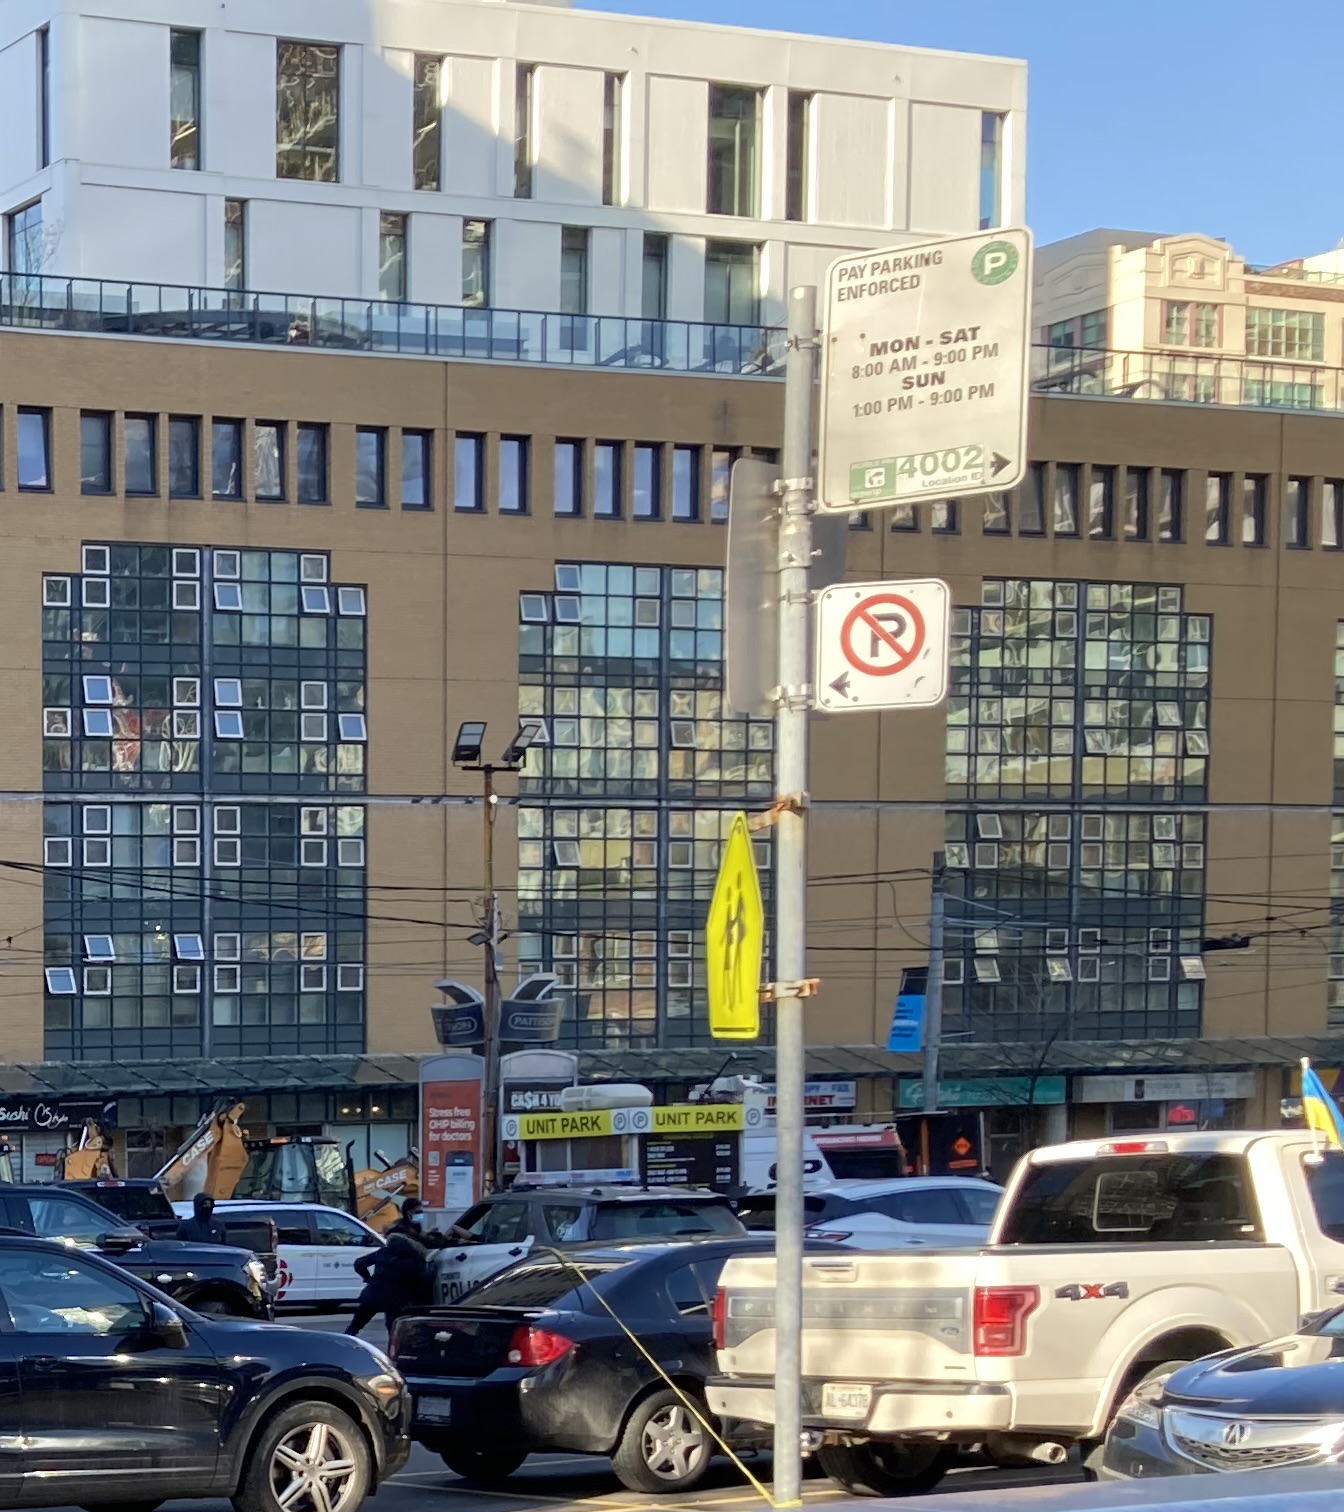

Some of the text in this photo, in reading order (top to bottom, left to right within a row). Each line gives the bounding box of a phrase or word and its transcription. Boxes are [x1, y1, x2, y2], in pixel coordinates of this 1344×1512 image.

[838, 250, 943, 282] PAY PARKING
[837, 274, 921, 302] ENFORCED
[869, 335, 920, 357] MON
[940, 325, 982, 346] SAT
[851, 361, 883, 379] 8:00
[888, 356, 917, 374] AM
[933, 348, 967, 367] 9:00
[972, 342, 999, 361] PM
[902, 371, 946, 390] SUN
[852, 400, 882, 418] 1:00
[887, 395, 913, 412] PM
[930, 388, 963, 406] 9:00
[968, 382, 995, 400] PM
[896, 445, 984, 478] 4002
[922, 472, 983, 488] Location ID
[429, 1106, 471, 1117] Stress free
[656, 1111, 737, 1126] UNIT PARK
[429, 1118, 475, 1131] OHIP billing
[527, 1115, 601, 1135] UNIT PARK
[429, 1130, 472, 1141] for doctors
[182, 1131, 214, 1166] CASE
[375, 1169, 407, 1189] CASE
